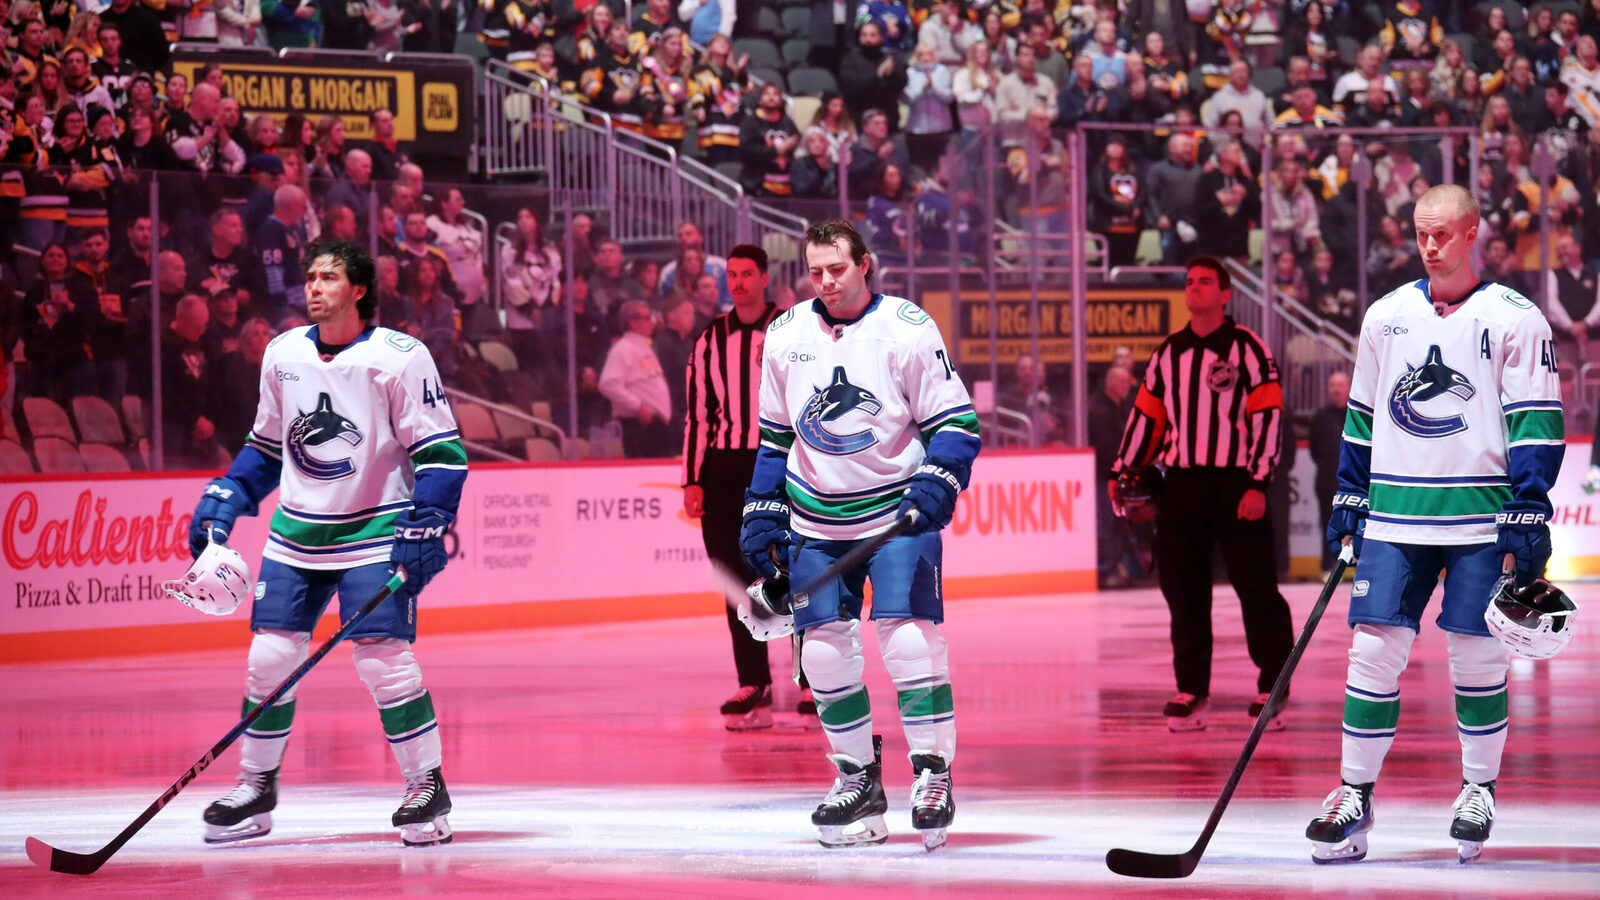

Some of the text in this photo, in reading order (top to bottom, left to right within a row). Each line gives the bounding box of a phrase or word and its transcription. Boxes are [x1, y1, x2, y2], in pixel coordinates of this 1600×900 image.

[222, 73, 390, 112] ORGAN & MORGAN
[971, 304, 1056, 335] MRGAN
[1481, 328, 1492, 360] A
[423, 375, 447, 409] 44
[577, 497, 662, 521] RIVERS
[952, 480, 1082, 537] DUNKIN'
[2, 488, 193, 571] Caliente
[395, 525, 444, 540] CCM
[655, 548, 709, 562] PITTSBU
[15, 582, 61, 609] Pizza
[66, 580, 83, 606] &
[88, 574, 134, 605] Draft
[158, 750, 215, 810] CCM
